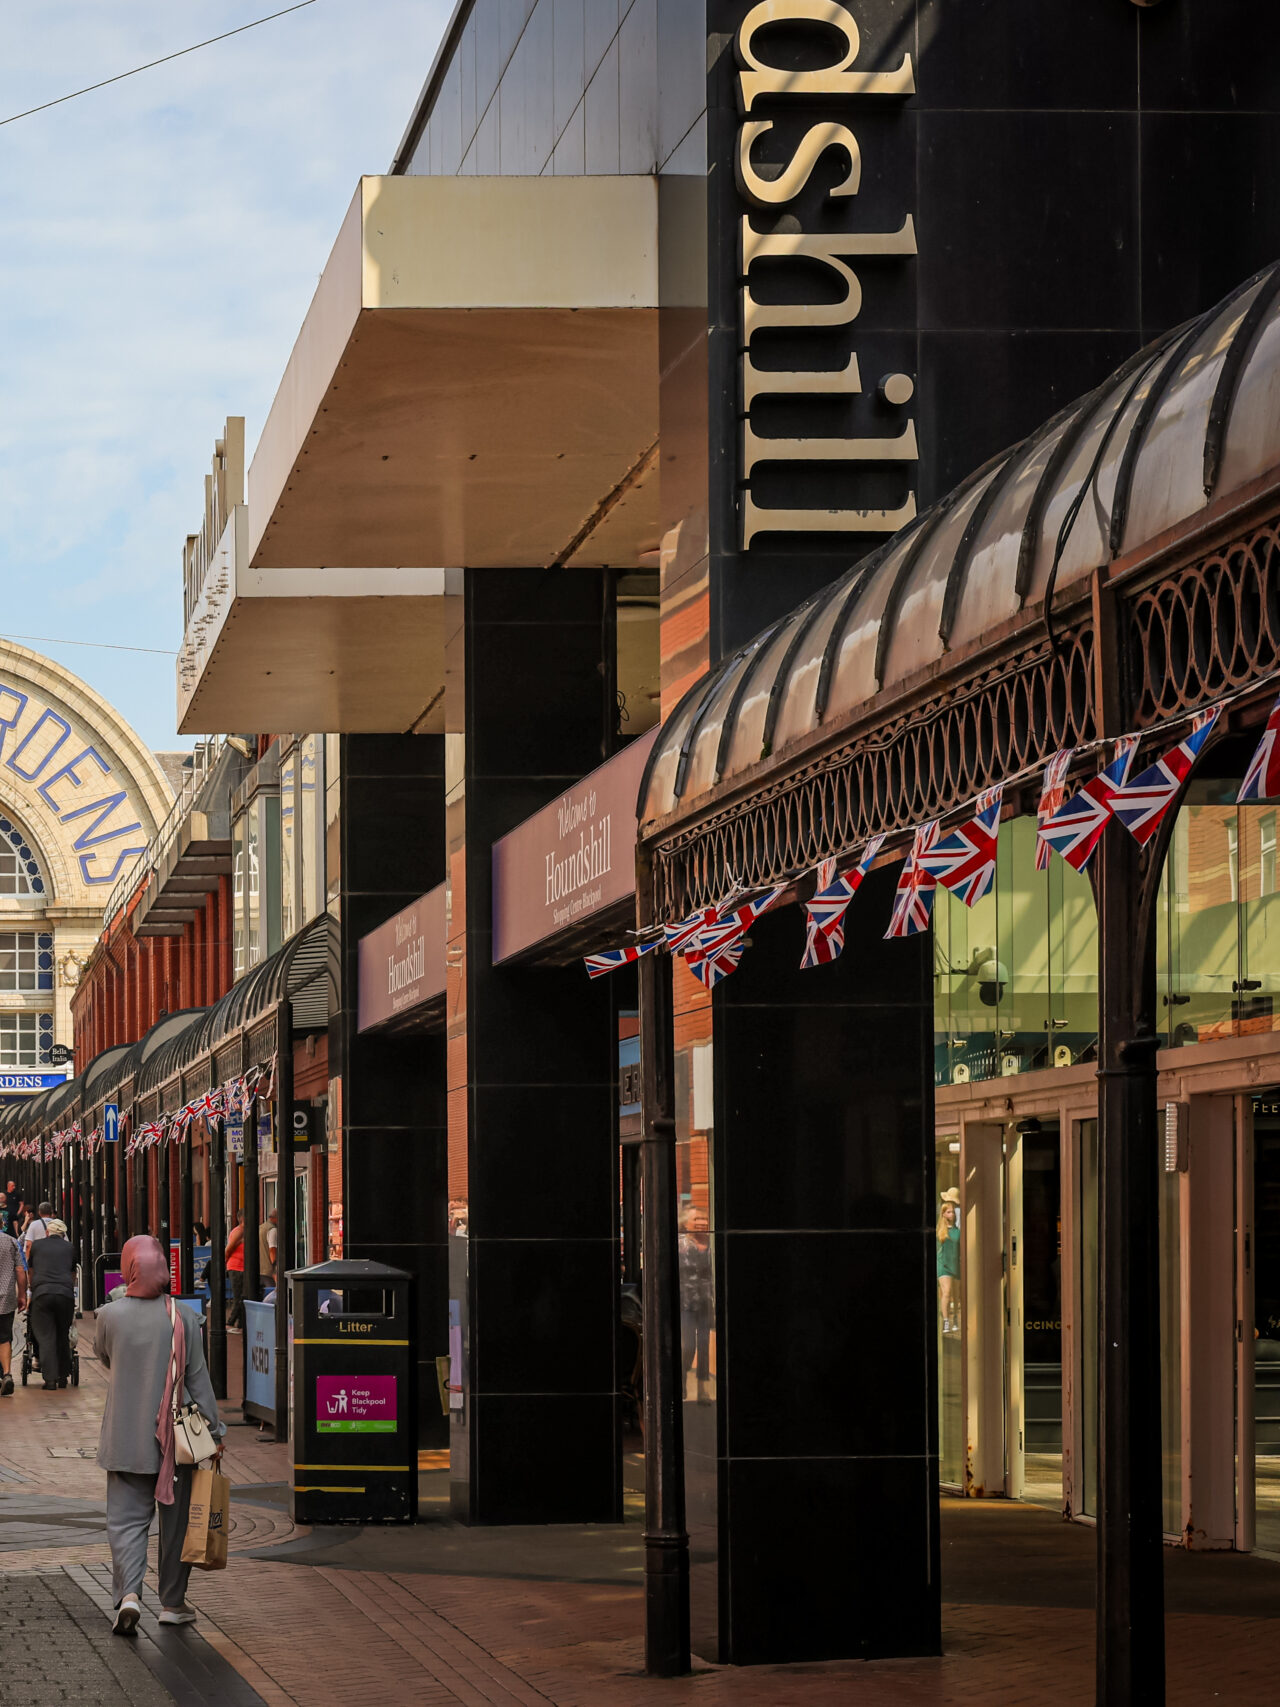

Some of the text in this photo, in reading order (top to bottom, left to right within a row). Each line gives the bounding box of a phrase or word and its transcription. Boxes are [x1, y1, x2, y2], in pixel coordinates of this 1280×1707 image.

[558, 796, 587, 840] Welcome
[545, 814, 611, 907] Houndshill
[388, 935, 425, 995] Houndshill
[339, 1322, 373, 1333] Litter
[252, 1348, 269, 1375] NERO
[352, 1389, 370, 1397] Keep
[352, 1398, 386, 1406] Blackpool
[352, 1407, 367, 1415] Tidy
